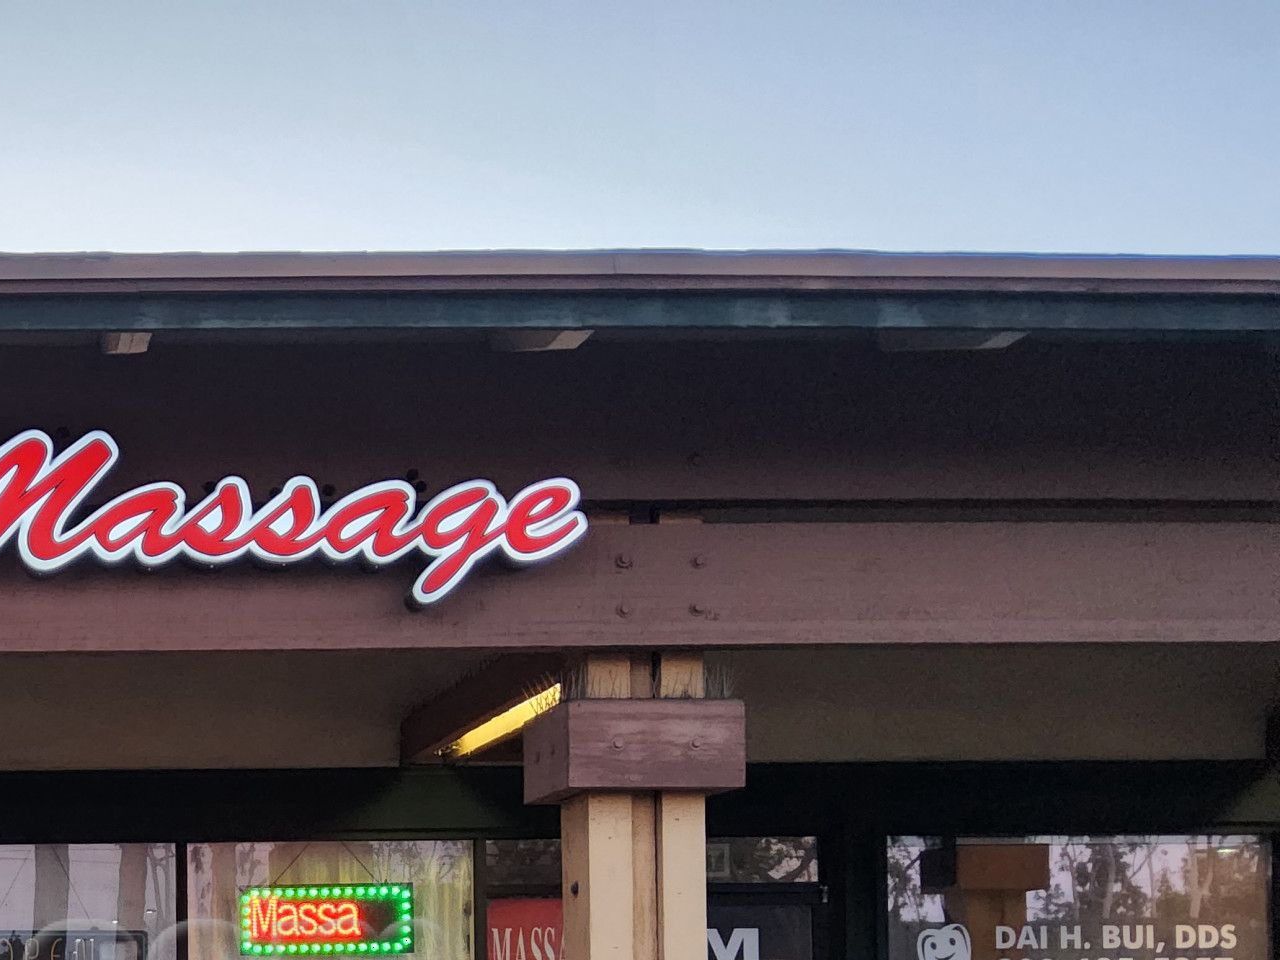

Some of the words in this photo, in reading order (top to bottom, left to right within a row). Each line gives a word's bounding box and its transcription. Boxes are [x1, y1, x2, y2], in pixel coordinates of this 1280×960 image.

[250, 895, 362, 938] Massa
[995, 925, 1047, 950] DAI
[1060, 925, 1091, 950] H.
[1102, 924, 1166, 953] BUI,
[1175, 923, 1237, 950] DDS
